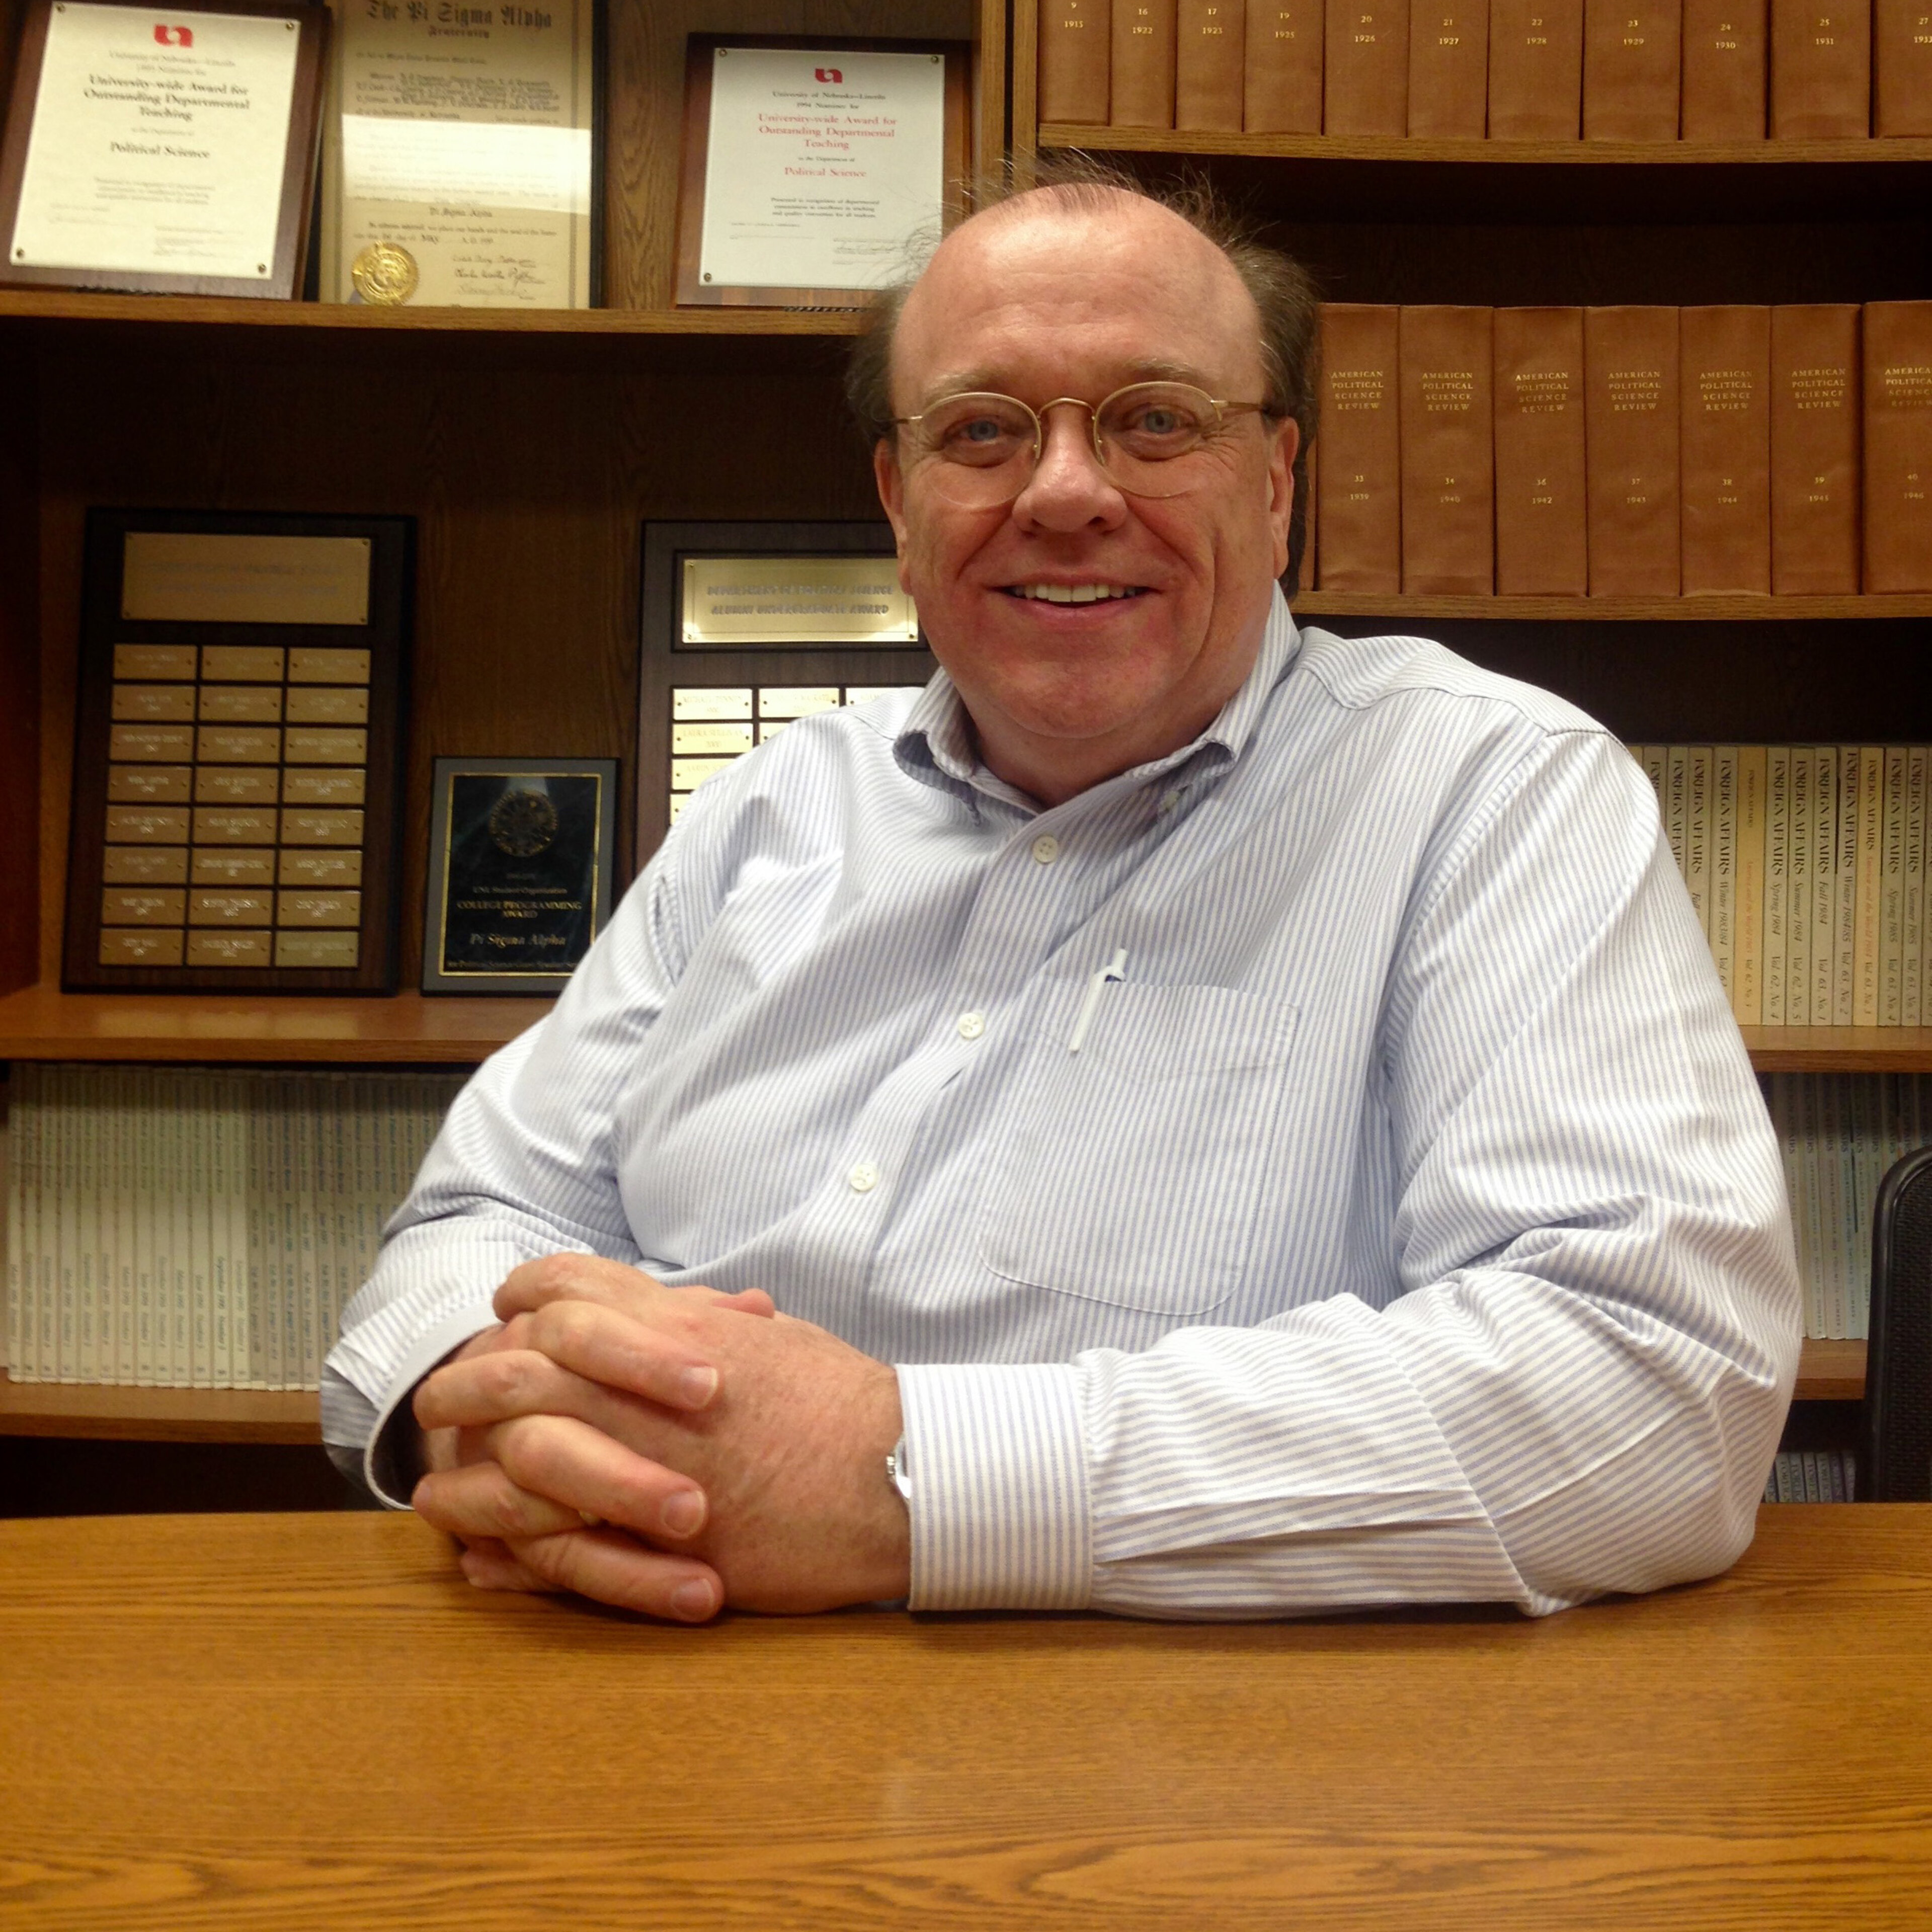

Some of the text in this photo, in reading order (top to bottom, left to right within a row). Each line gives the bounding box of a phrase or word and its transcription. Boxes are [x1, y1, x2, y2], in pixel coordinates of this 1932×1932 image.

[438, 2, 492, 26] Sigma
[501, 6, 551, 28] Alpha
[1918, 17, 1928, 25] 27
[84, 88, 250, 109] Outstanding Departmental
[191, 82, 226, 94] Award
[230, 84, 248, 95] for
[139, 106, 193, 122] Teaching
[759, 113, 897, 125] University-wide Award for
[759, 126, 895, 137] Outstanding Departmental
[111, 141, 210, 158] Political Science
[806, 139, 849, 150] Teaching
[785, 167, 866, 177] Political Science
[1515, 372, 1568, 381] AMERICAN
[1700, 371, 1750, 379] AMERICAN
[1792, 369, 1845, 377] AMERICAN
[1792, 379, 1845, 387] POLITICAL
[1516, 383, 1569, 391] POLITICAL
[1700, 381, 1752, 389] POLITICAL
[1795, 390, 1843, 398] SCIENCE
[1519, 393, 1567, 401] SCIENCE
[1612, 392, 1658, 400] SCIENCE
[1703, 392, 1749, 400] SCIENCE
[1797, 400, 1840, 409] REVIEW
[1522, 404, 1564, 413] REVIEW
[1706, 403, 1747, 411] REVIEW
[850, 605, 889, 614] AWARD
[1693, 759, 1705, 814] FOREIGN
[1720, 760, 1731, 815] FOREIGN
[1773, 760, 1785, 816] FOREIGN
[1795, 760, 1807, 816] FOREIGN
[1818, 758, 1830, 814] FOREIGN
[1846, 753, 1857, 808] FOREIGN
[1867, 760, 1877, 803] FOREIGN
[1910, 758, 1922, 813] FOREIGN
[1671, 760, 1683, 868] FOREIGN AFFAI
[1866, 807, 1876, 850] AFFAIRS
[1692, 817, 1703, 874] AFFAIRS
[1718, 818, 1730, 875] AFFAIRS
[1772, 818, 1784, 875] AFFAIRS
[1794, 819, 1806, 875] AFFAIRS
[1818, 817, 1830, 874] AFFAIRS
[1843, 812, 1856, 867] AFFAIRS
[1887, 758, 1902, 942] FOREIGN AFFAIRS Spring 1985
[1908, 816, 1920, 873] AFFAIRS
[1719, 881, 1728, 908] Winter
[1770, 882, 1782, 911] Spring
[1794, 882, 1804, 916] Summer
[1819, 881, 1828, 900] Fall
[1843, 875, 1852, 904] Winter
[1819, 902, 1827, 924] 1984
[1908, 887, 1917, 920] Summer
[1772, 914, 1781, 935] 1984
[1794, 920, 1802, 941] 1984
[488, 933, 525, 948] Sigma
[531, 933, 566, 949] Alpha
